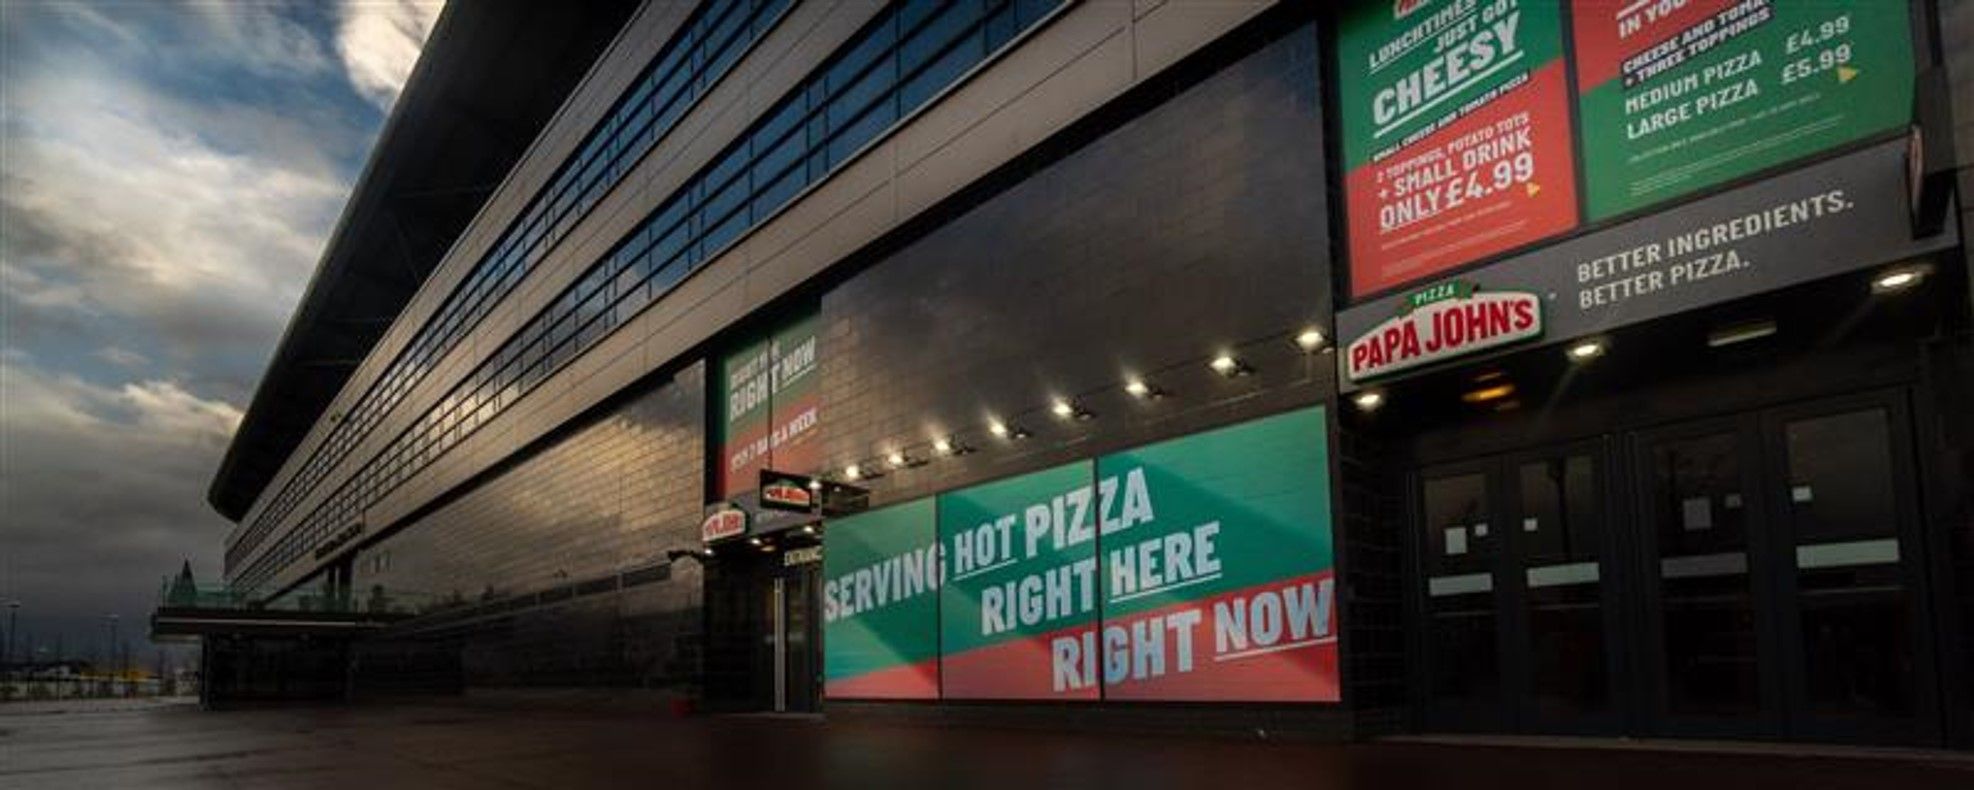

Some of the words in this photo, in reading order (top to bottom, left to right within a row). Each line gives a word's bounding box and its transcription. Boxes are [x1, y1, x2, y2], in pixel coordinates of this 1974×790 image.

[1369, 0, 1477, 68] LUNCHTIMES
[1434, 14, 1478, 52] JUST
[1619, 16, 1641, 39] IN
[1645, 0, 1686, 22] YOU
[1623, 37, 1679, 74] CHEESE
[1682, 21, 1715, 46] AND
[1717, 0, 1770, 26] TOMA
[1636, 52, 1686, 82] THREE
[1687, 7, 1771, 57] TOPPINGS
[1373, 10, 1520, 125] CHEESY
[1624, 73, 1699, 115] MEDIUM
[1703, 50, 1762, 84] PIZZA
[1448, 127, 1494, 153] POTATO
[1497, 112, 1530, 134] TOTS
[1627, 103, 1691, 140] LARGE
[1696, 79, 1759, 115] PIZZA
[1380, 185, 1442, 230] ONLY
[1446, 152, 1534, 208] £4.99
[1394, 158, 1459, 197] SMALL
[1462, 130, 1532, 171] DRINK
[1578, 243, 1661, 283] BETTER
[1667, 189, 1854, 257] INGREDIENTS.
[1415, 284, 1455, 306] PIZZA
[1579, 271, 1663, 309] BETTER
[1670, 250, 1751, 286] PIZZA.
[1353, 320, 1421, 373] PAPA
[1426, 299, 1534, 354] JOHN'S
[730, 361, 780, 422] RIGHT
[824, 541, 947, 623] SERVING
[954, 514, 1018, 575] HOT
[1025, 466, 1155, 559] PIZZA
[981, 556, 1099, 636] RIGHT
[1110, 521, 1222, 596] HERE
[1052, 609, 1201, 693] RIGHT
[1214, 579, 1336, 654] NOW
